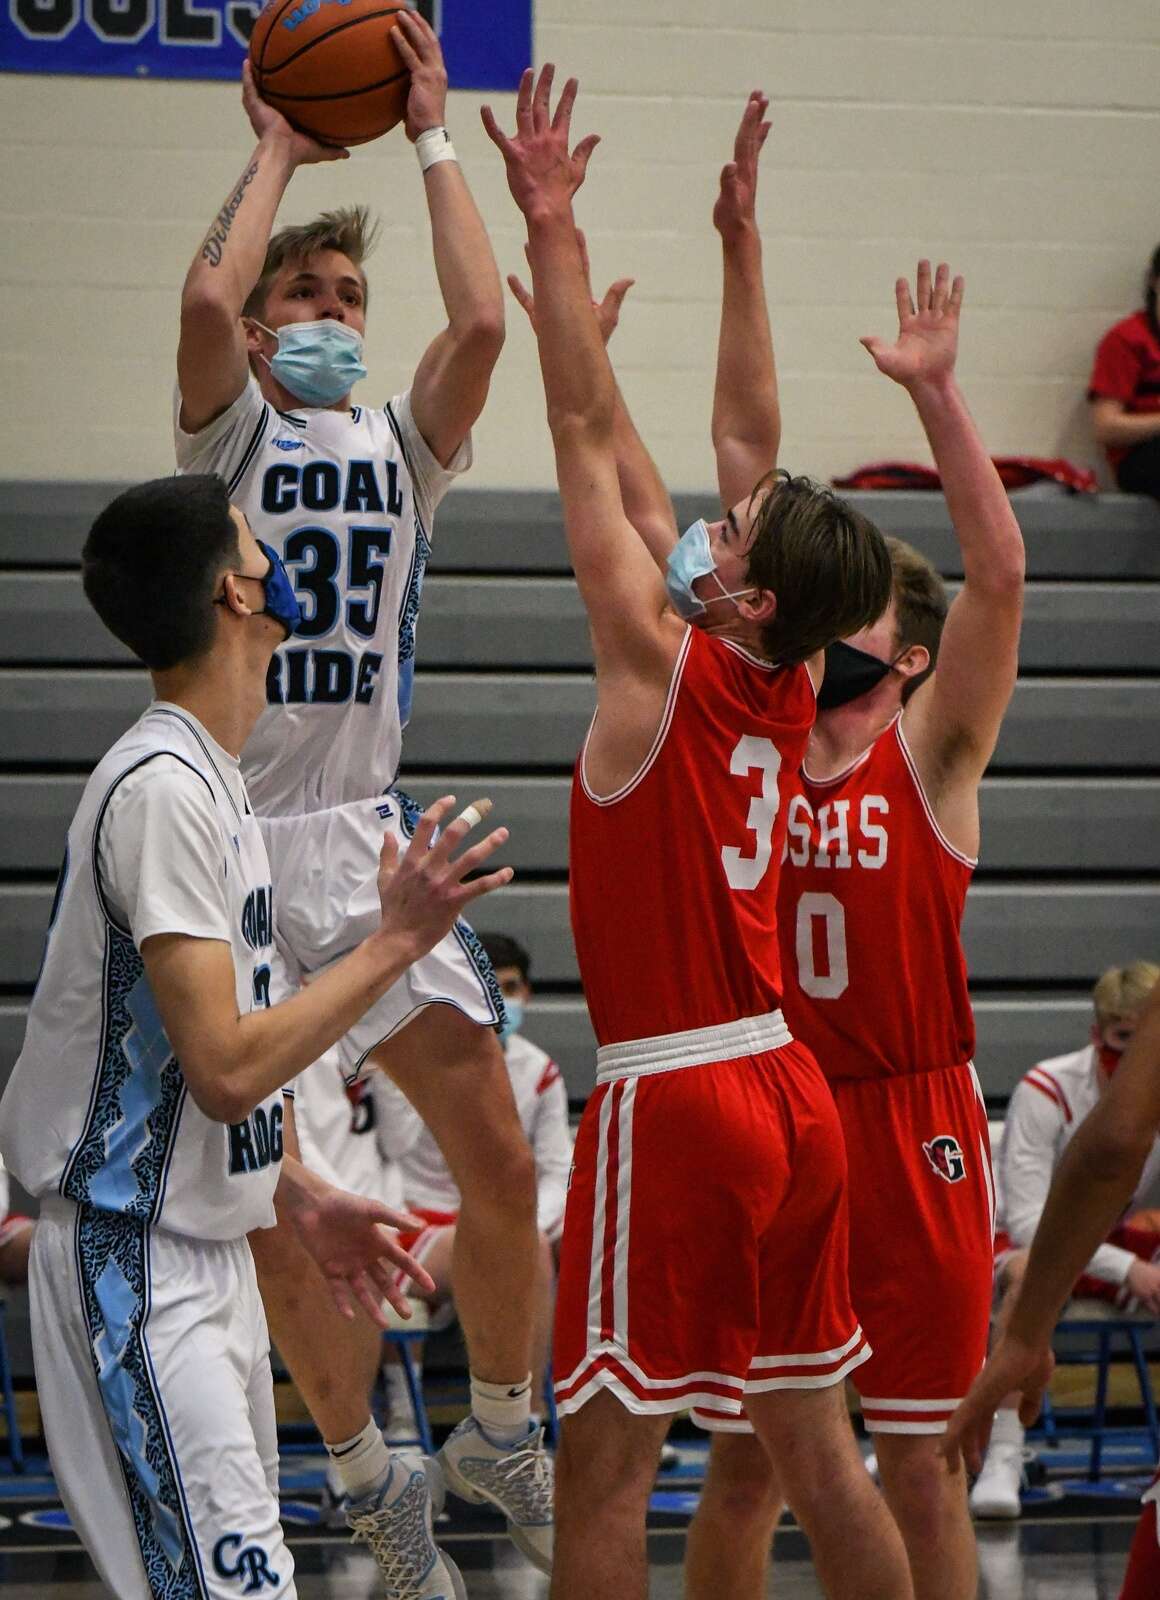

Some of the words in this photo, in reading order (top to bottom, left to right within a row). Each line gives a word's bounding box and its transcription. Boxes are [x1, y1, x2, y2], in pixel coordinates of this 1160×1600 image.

[261, 459, 404, 516] COAL
[283, 526, 392, 640] 35
[721, 734, 782, 890] 3
[781, 794, 889, 869] SHS
[796, 892, 849, 999] 0
[213, 1533, 279, 1594] CR
